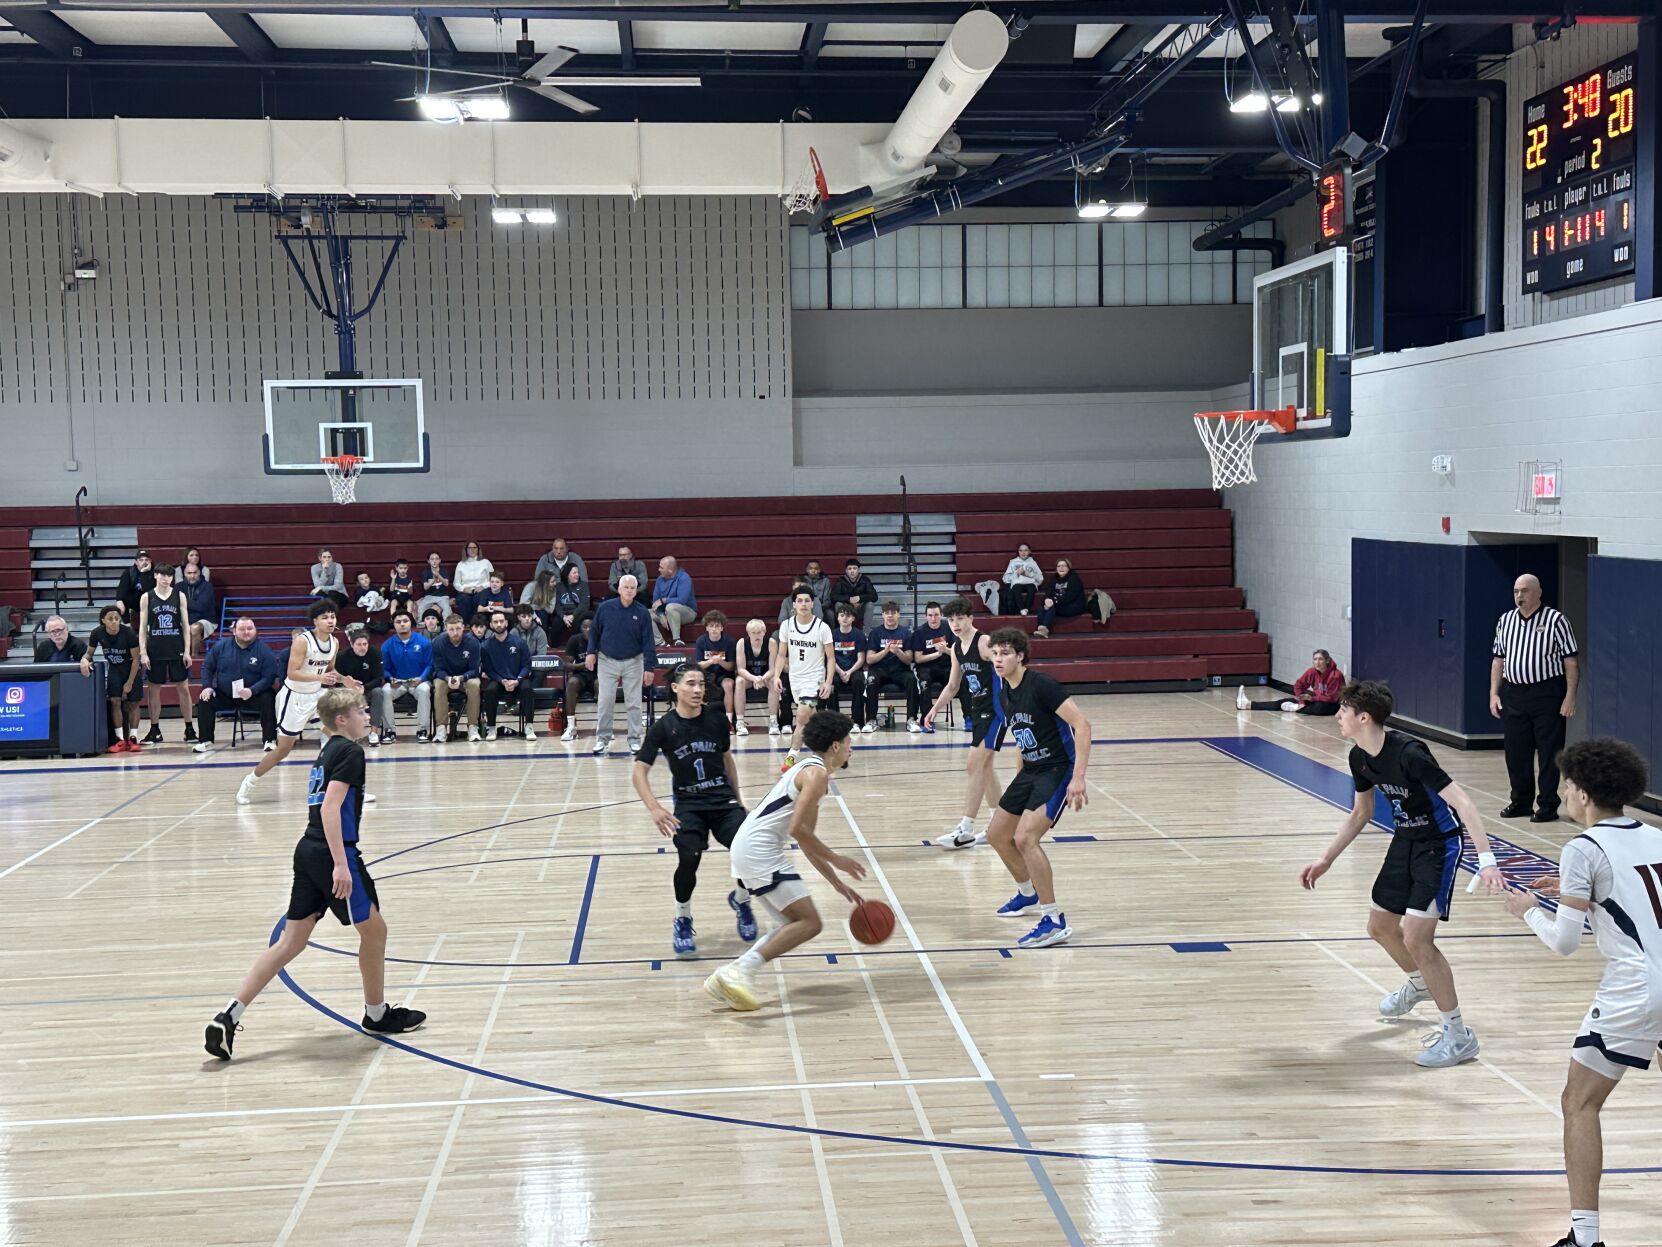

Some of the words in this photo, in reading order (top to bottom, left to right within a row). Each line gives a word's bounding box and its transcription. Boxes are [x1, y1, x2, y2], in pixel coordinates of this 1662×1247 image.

[1607, 65, 1633, 88] Guests
[1528, 103, 1545, 124] Home
[1607, 88, 1633, 138] 20
[1526, 124, 1548, 170] 22
[1591, 138, 1601, 169] 2
[1564, 150, 1586, 178] period
[1613, 170, 1631, 191] fouls
[1564, 186, 1587, 209] player
[1526, 201, 1540, 220] fouls
[1622, 202, 1628, 230] 1
[1595, 209, 1605, 236] 4
[1533, 229, 1538, 256] 1
[1545, 224, 1555, 251] 4
[1614, 246, 1629, 263] won
[1566, 258, 1584, 279] game
[158, 614, 173, 628] 12
[799, 649, 806, 661] 5
[693, 758, 705, 780] 1
